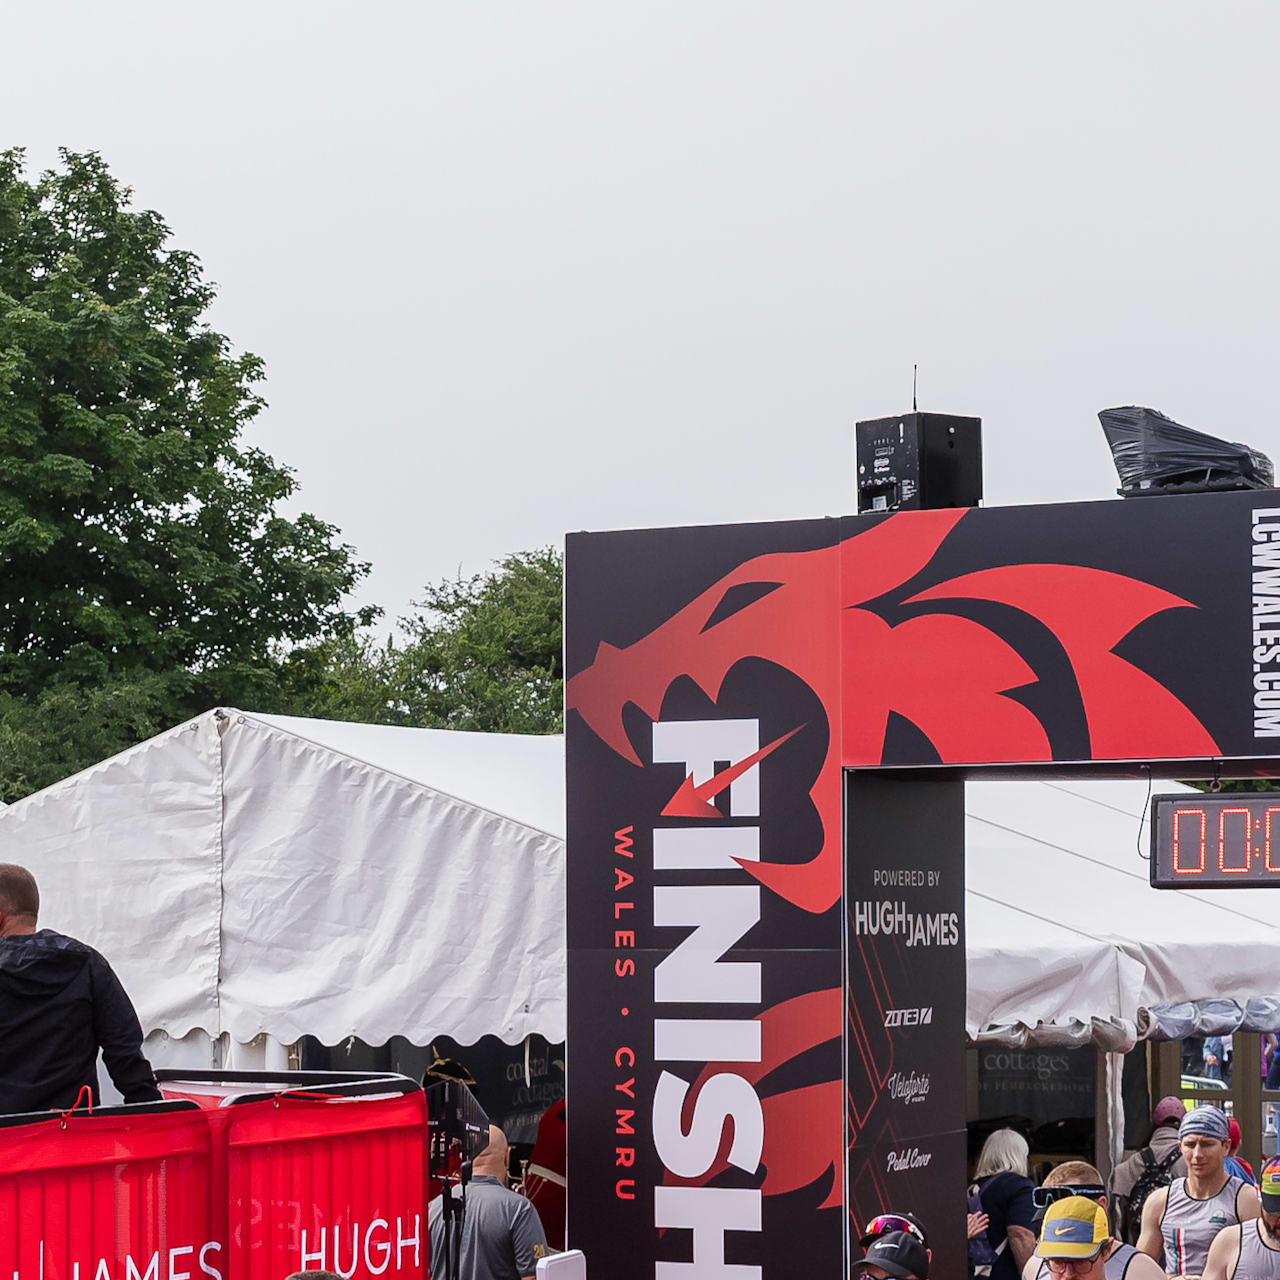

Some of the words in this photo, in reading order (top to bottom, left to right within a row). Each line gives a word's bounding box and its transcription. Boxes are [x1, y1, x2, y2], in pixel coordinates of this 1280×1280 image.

[614, 824, 636, 978] WALES
[873, 870, 924, 887] POWERED
[927, 870, 941, 887] BY
[614, 1047, 636, 1200] CYMRU
[300, 1212, 421, 1280] HUGH
